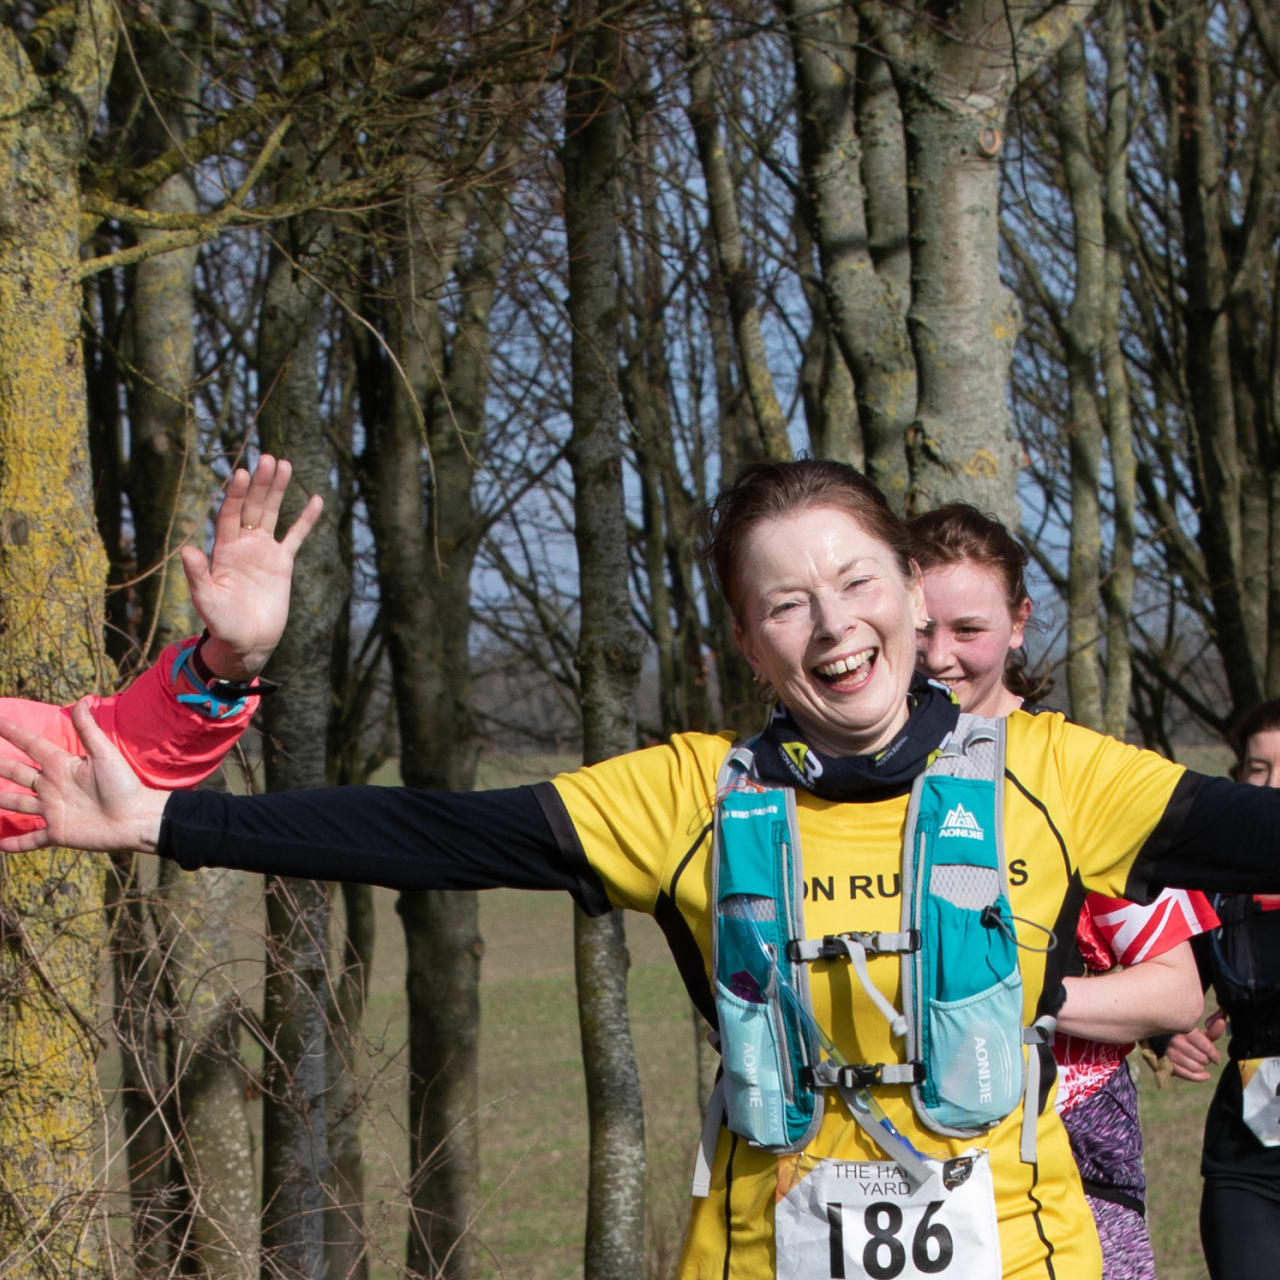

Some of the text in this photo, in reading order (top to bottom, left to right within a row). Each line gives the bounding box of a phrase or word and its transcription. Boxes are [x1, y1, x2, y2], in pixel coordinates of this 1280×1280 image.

[939, 828, 984, 840] AONIJIE
[974, 1036, 992, 1105] AONIJIE
[833, 1163, 908, 1179] THE HA
[859, 1182, 911, 1196] YARD
[826, 1201, 953, 1280] 186
